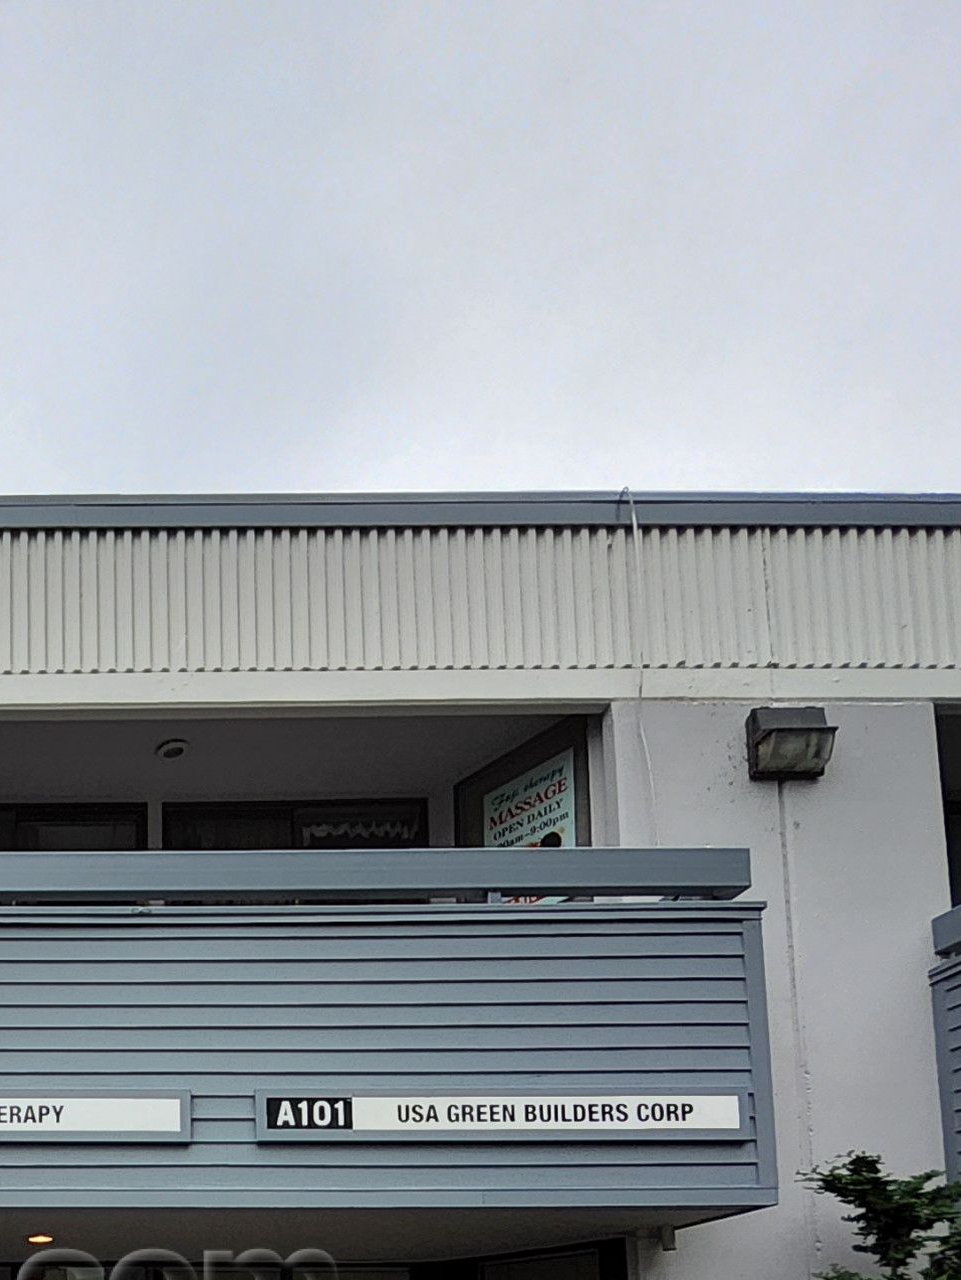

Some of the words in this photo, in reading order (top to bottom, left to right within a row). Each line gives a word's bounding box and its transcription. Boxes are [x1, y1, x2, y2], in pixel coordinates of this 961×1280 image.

[487, 777, 569, 831] MASSAGE
[493, 819, 525, 841] OPEN
[526, 798, 564, 824] DAILY
[276, 1101, 347, 1127] A101
[397, 1104, 439, 1123] USA
[447, 1104, 515, 1123] GREEN
[524, 1103, 629, 1123] BUILDERS
[637, 1103, 694, 1122] CORP
